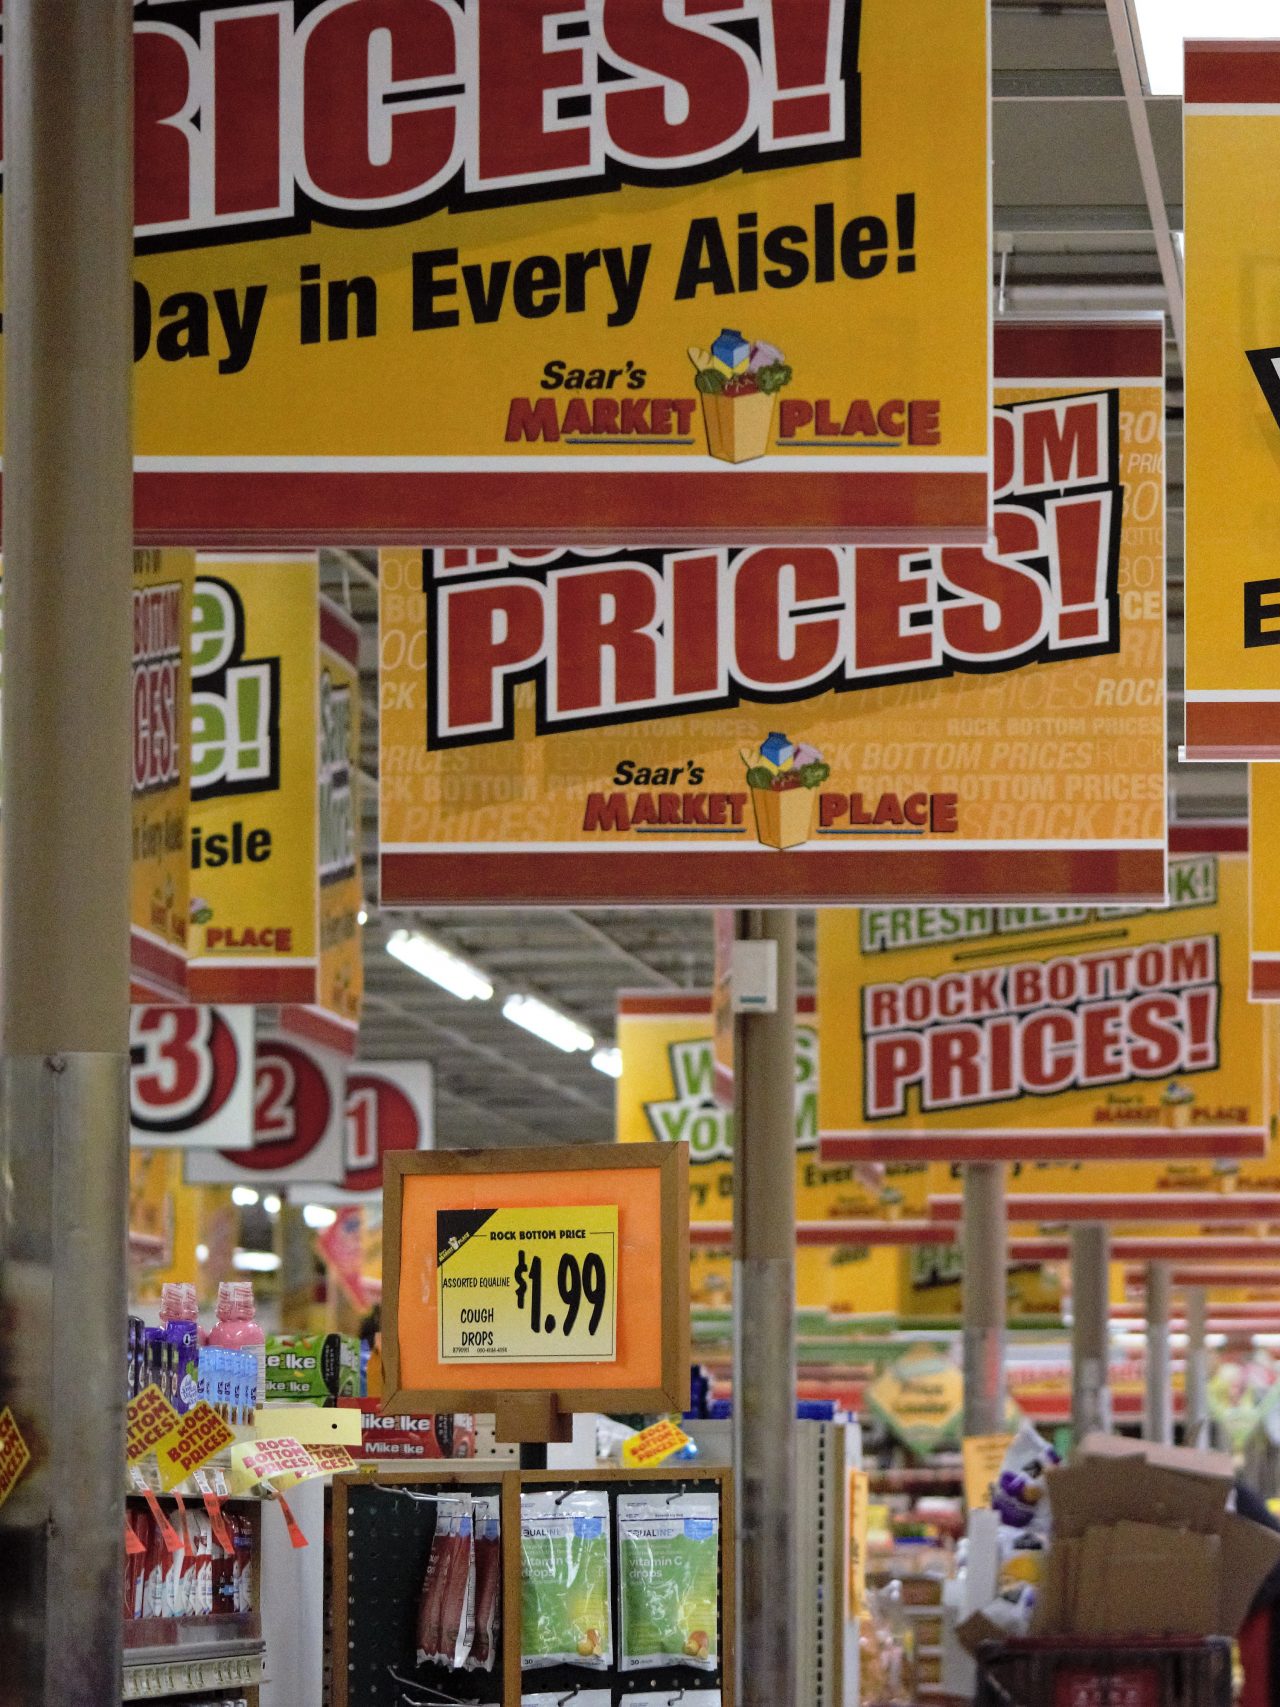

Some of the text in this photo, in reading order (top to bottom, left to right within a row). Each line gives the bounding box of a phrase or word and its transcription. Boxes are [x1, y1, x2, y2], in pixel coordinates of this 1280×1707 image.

[135, 0, 846, 237] ICES!
[301, 265, 377, 345] in
[411, 243, 652, 332] Every
[674, 192, 917, 301] Aisle!
[540, 360, 646, 391] Saar's
[504, 397, 698, 443] MARKET
[779, 397, 941, 446] PLACE
[437, 490, 1113, 738] PRICES!
[613, 760, 705, 786] Saar's
[582, 792, 959, 833] MARKET PLACE
[191, 821, 272, 869] isle
[206, 927, 293, 953] PLACE
[868, 938, 1212, 1033] ROCK BOTTOM
[136, 1006, 211, 1114] 3
[869, 987, 1217, 1116] PRICES!
[490, 1229, 586, 1241] ROCK BOTTOM PRICE
[443, 1277, 511, 1288] ASSORTED EQUALINE
[514, 1250, 606, 1337] $1.99
[460, 1308, 494, 1324] COUGH
[461, 1331, 494, 1346] DROPS
[127, 1387, 162, 1421] OCK
[127, 1402, 171, 1441] TTOM
[167, 1415, 224, 1463] BOTTOM
[180, 1426, 232, 1472] PRICES!
[242, 1446, 308, 1469] BOTTOM
[255, 1437, 300, 1451] ROCK
[629, 1555, 683, 1567] vitamin C
